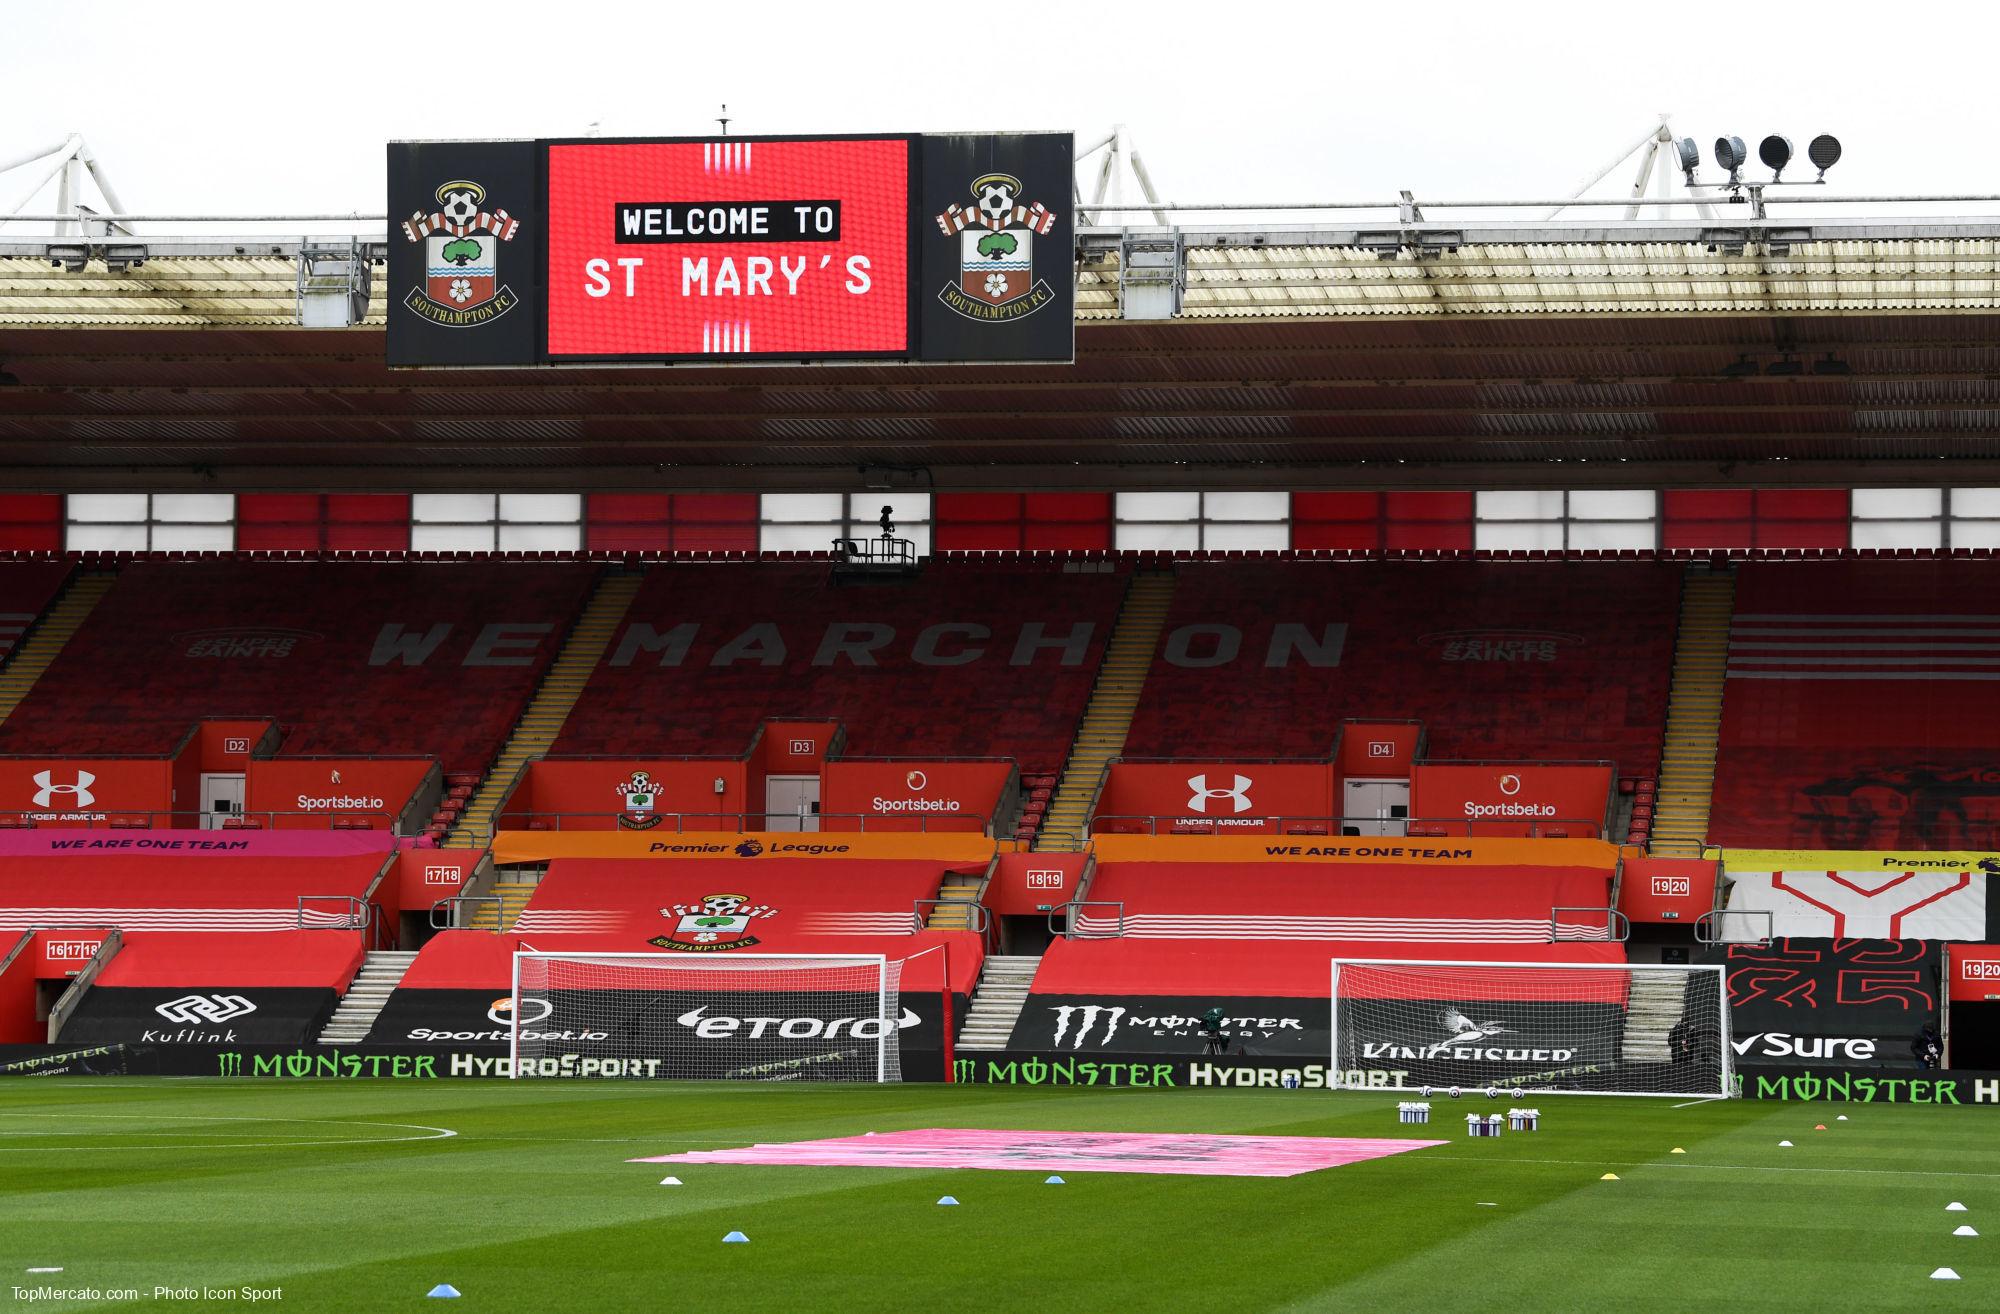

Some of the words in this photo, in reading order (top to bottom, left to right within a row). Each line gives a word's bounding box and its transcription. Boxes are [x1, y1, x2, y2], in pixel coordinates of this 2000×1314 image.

[623, 207, 769, 236] WELCOME
[794, 206, 833, 234] TO
[585, 257, 643, 298] ST
[682, 254, 871, 297] MARY'S
[411, 296, 495, 324] SOUTHAMPTON
[494, 294, 510, 311] FC
[946, 290, 1030, 319] SOUTHAMPTON
[1030, 289, 1046, 306] FC
[186, 646, 292, 658] SAINTS
[368, 623, 556, 667] WE
[608, 622, 1096, 668] MARCH
[1163, 622, 1349, 668] ON
[1440, 649, 1557, 662] SAINTS
[229, 741, 245, 751] D2
[794, 742, 810, 752] D3
[1373, 745, 1390, 755] D4
[297, 795, 384, 811] Sportsbet.io
[873, 797, 960, 813] Sportsbet.io
[1464, 801, 1556, 818] Sportsbet.io
[51, 840, 87, 849] WE
[90, 839, 134, 849] ARE
[136, 839, 183, 849] ONE
[187, 841, 249, 850] TEAM
[650, 842, 729, 853] Premier
[770, 842, 850, 855] League
[1265, 846, 1302, 856] WE
[1305, 847, 1351, 857] ARE
[1355, 847, 1404, 857] ONE
[1408, 848, 1473, 859] TEAM
[1883, 858, 1970, 867] Premier
[427, 870, 442, 880] 17
[444, 870, 458, 880] 18
[1029, 874, 1043, 885] 18
[1046, 874, 1060, 885] 19
[1654, 881, 1669, 892] 19
[1672, 881, 1687, 892] 20
[50, 945, 64, 956] 16
[67, 945, 81, 956] 17
[84, 945, 98, 956] 18
[655, 938, 736, 952] SOUTHAMPTON
[1965, 964, 1981, 976] 19
[1984, 964, 2000, 976] 20
[1129, 1015, 1304, 1030] MONSTER
[142, 1029, 238, 1043] Kuflink
[407, 1028, 610, 1042] Sportsbet.io
[1153, 1030, 1276, 1039] ENERGY
[1762, 1032, 1877, 1060] Sure
[7, 1046, 110, 1072] MONSTER
[253, 1049, 438, 1078] MONSTER
[450, 1053, 662, 1078] HYDROSPORT
[987, 1056, 1175, 1087] MONSTER
[1190, 1062, 1409, 1090] HYDROSPORT
[1757, 1071, 1961, 1105] MONSTER
